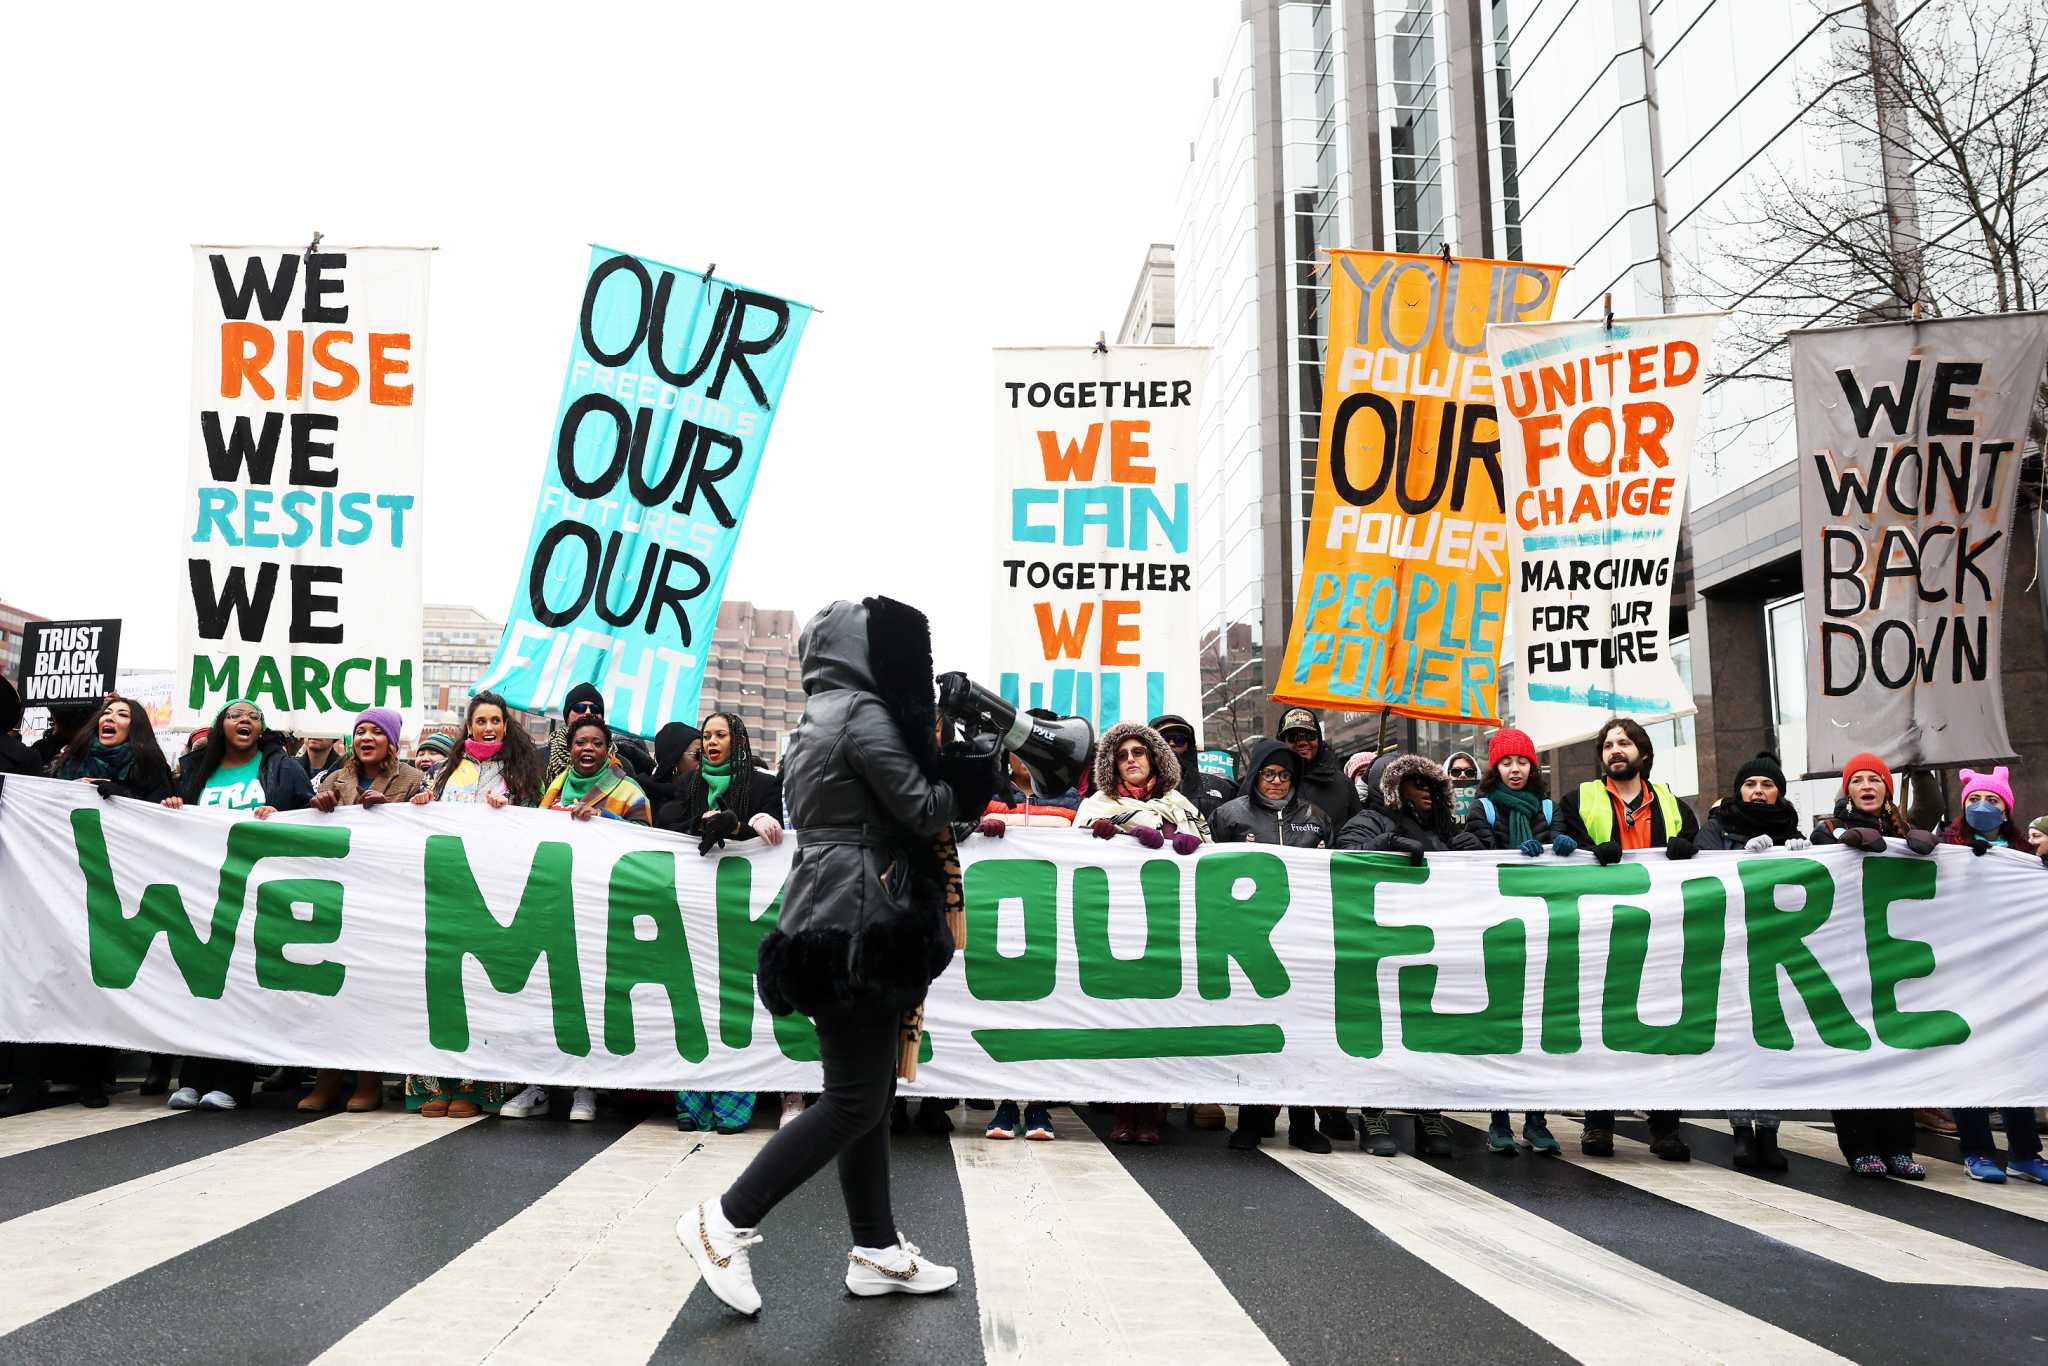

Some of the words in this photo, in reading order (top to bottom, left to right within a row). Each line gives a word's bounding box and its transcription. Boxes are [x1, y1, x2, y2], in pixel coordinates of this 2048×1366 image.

[209, 253, 348, 323] WE
[1340, 255, 1550, 355] YOUR
[220, 322, 413, 406] RISE
[580, 254, 789, 411] OUR
[570, 359, 757, 437] FREEDOMS
[1005, 380, 1192, 409] TOGETHER
[1337, 346, 1495, 402] POWE
[1501, 340, 1699, 418] UNITED
[1835, 359, 1983, 438] WE
[201, 411, 338, 487] WE
[557, 392, 742, 528] OUR
[1037, 420, 1156, 484] WE
[1330, 392, 1506, 515] OUR
[1518, 401, 1674, 488] FOR
[1814, 441, 2014, 517] WONT
[191, 488, 414, 548] RESIST
[540, 486, 718, 561] FUTURES
[1012, 482, 1189, 553] CAN
[1325, 505, 1506, 577] POWER
[1515, 477, 1675, 531] CHANGE
[189, 559, 343, 644] WE
[529, 520, 710, 648] OUR
[1003, 559, 1191, 592] TOGETHER
[1521, 557, 1670, 593] MARCHING
[1823, 525, 2002, 618] BACK
[38, 627, 103, 651] TRUST
[1034, 600, 1141, 666] WE
[1304, 571, 1502, 653] PEOPLE
[1532, 604, 1590, 632] FOR
[1611, 600, 1653, 629] OUR
[26, 674, 109, 700] WOMEN.
[34, 650, 100, 675] BLACK
[189, 654, 413, 712] MARCH
[1294, 631, 1495, 718] POWER
[1527, 630, 1658, 674] FUTURE
[1823, 615, 1988, 696] DOWN
[424, 834, 932, 1063] MAK
[963, 851, 1291, 1001] OUR
[1329, 851, 1971, 1060] FUTURE
